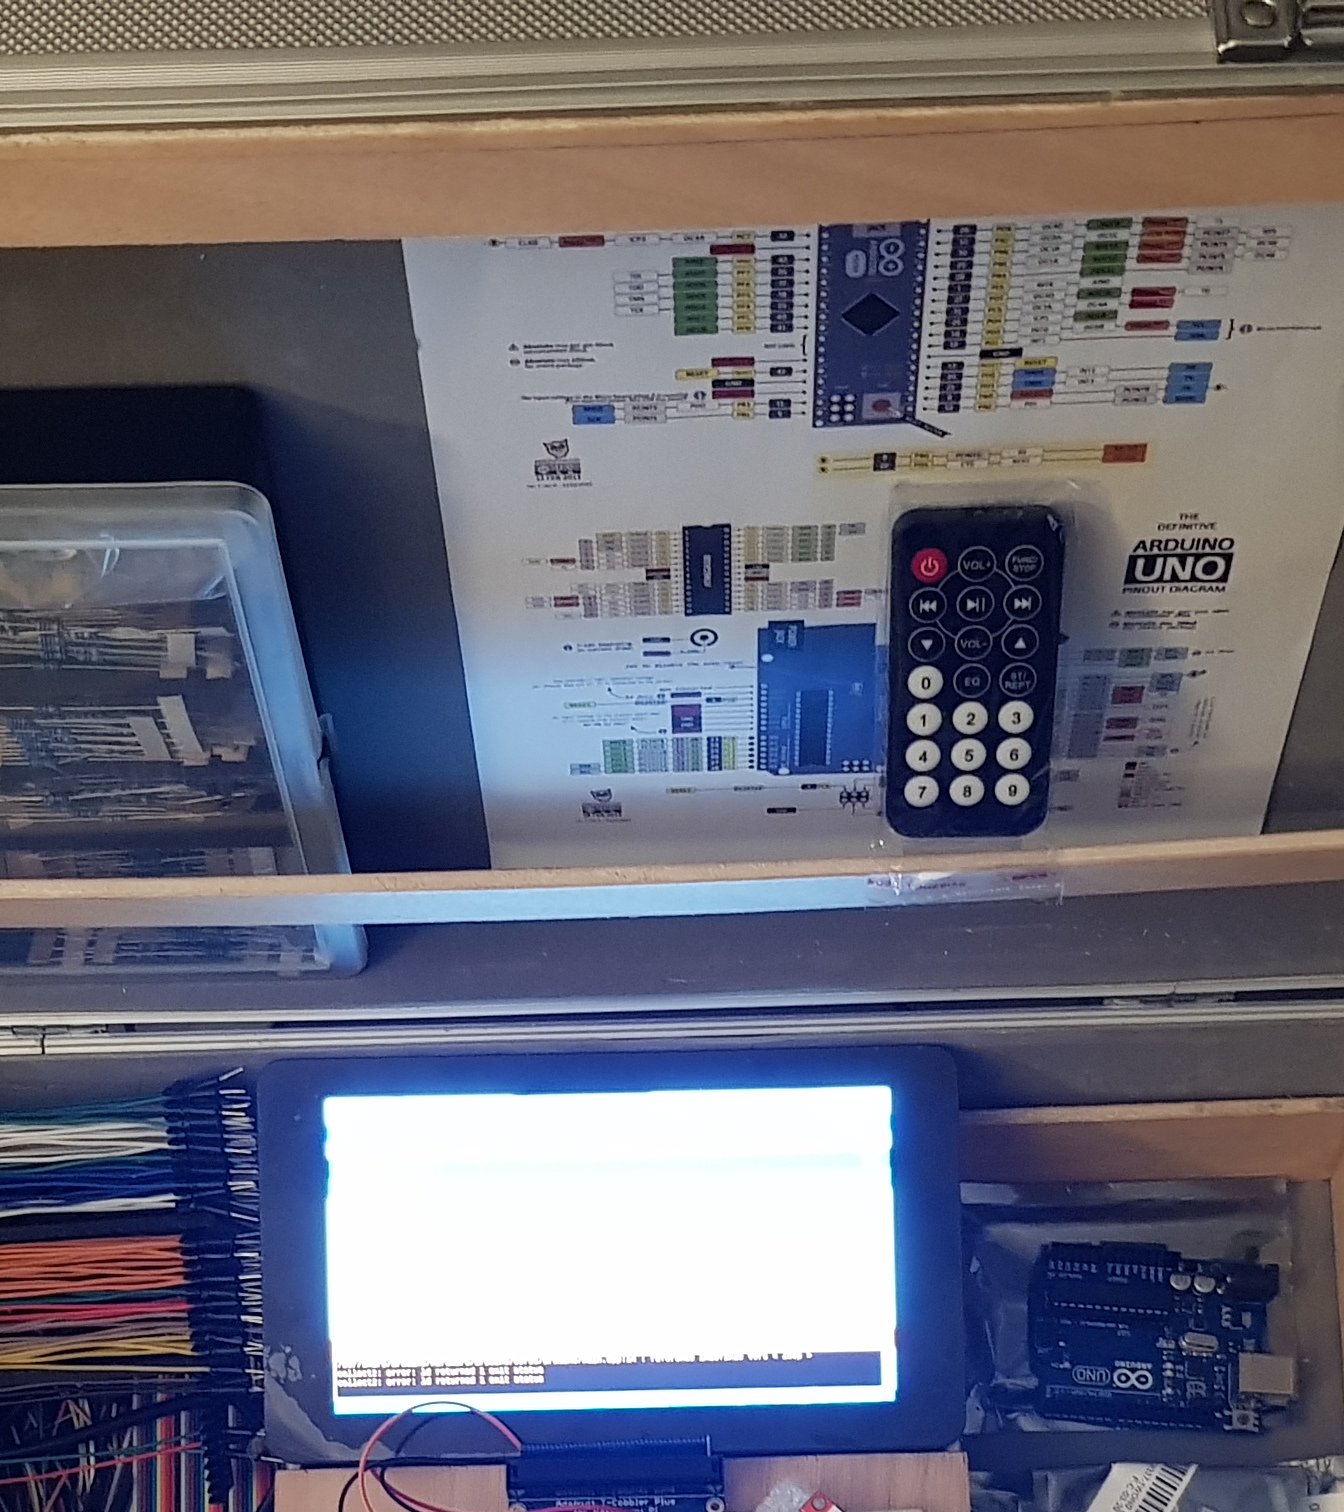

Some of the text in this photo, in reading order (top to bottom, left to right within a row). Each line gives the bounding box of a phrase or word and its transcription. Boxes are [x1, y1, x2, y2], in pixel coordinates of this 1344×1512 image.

[1178, 512, 1200, 520] THE
[1157, 522, 1218, 532] DEFINITIVE
[1132, 537, 1235, 553] ARDUINO
[962, 560, 992, 571] VOL+
[1012, 564, 1036, 573] STOP
[1134, 555, 1226, 582] UNO
[1122, 585, 1226, 594] PINOUT DIAGRAM
[921, 676, 931, 690] 0
[964, 677, 980, 687] EQ
[1004, 680, 1032, 690] REPT
[920, 714, 926, 727] 1
[966, 712, 976, 726] 2
[1012, 711, 1022, 725] 3
[918, 750, 928, 763] 4
[964, 748, 974, 762] 5
[1009, 748, 1019, 761] 6
[918, 786, 927, 800] 7
[962, 785, 972, 798] 8
[1008, 784, 1018, 797] 9
[1076, 1368, 1106, 1382] UNO
[654, 1498, 676, 1506] Plus
